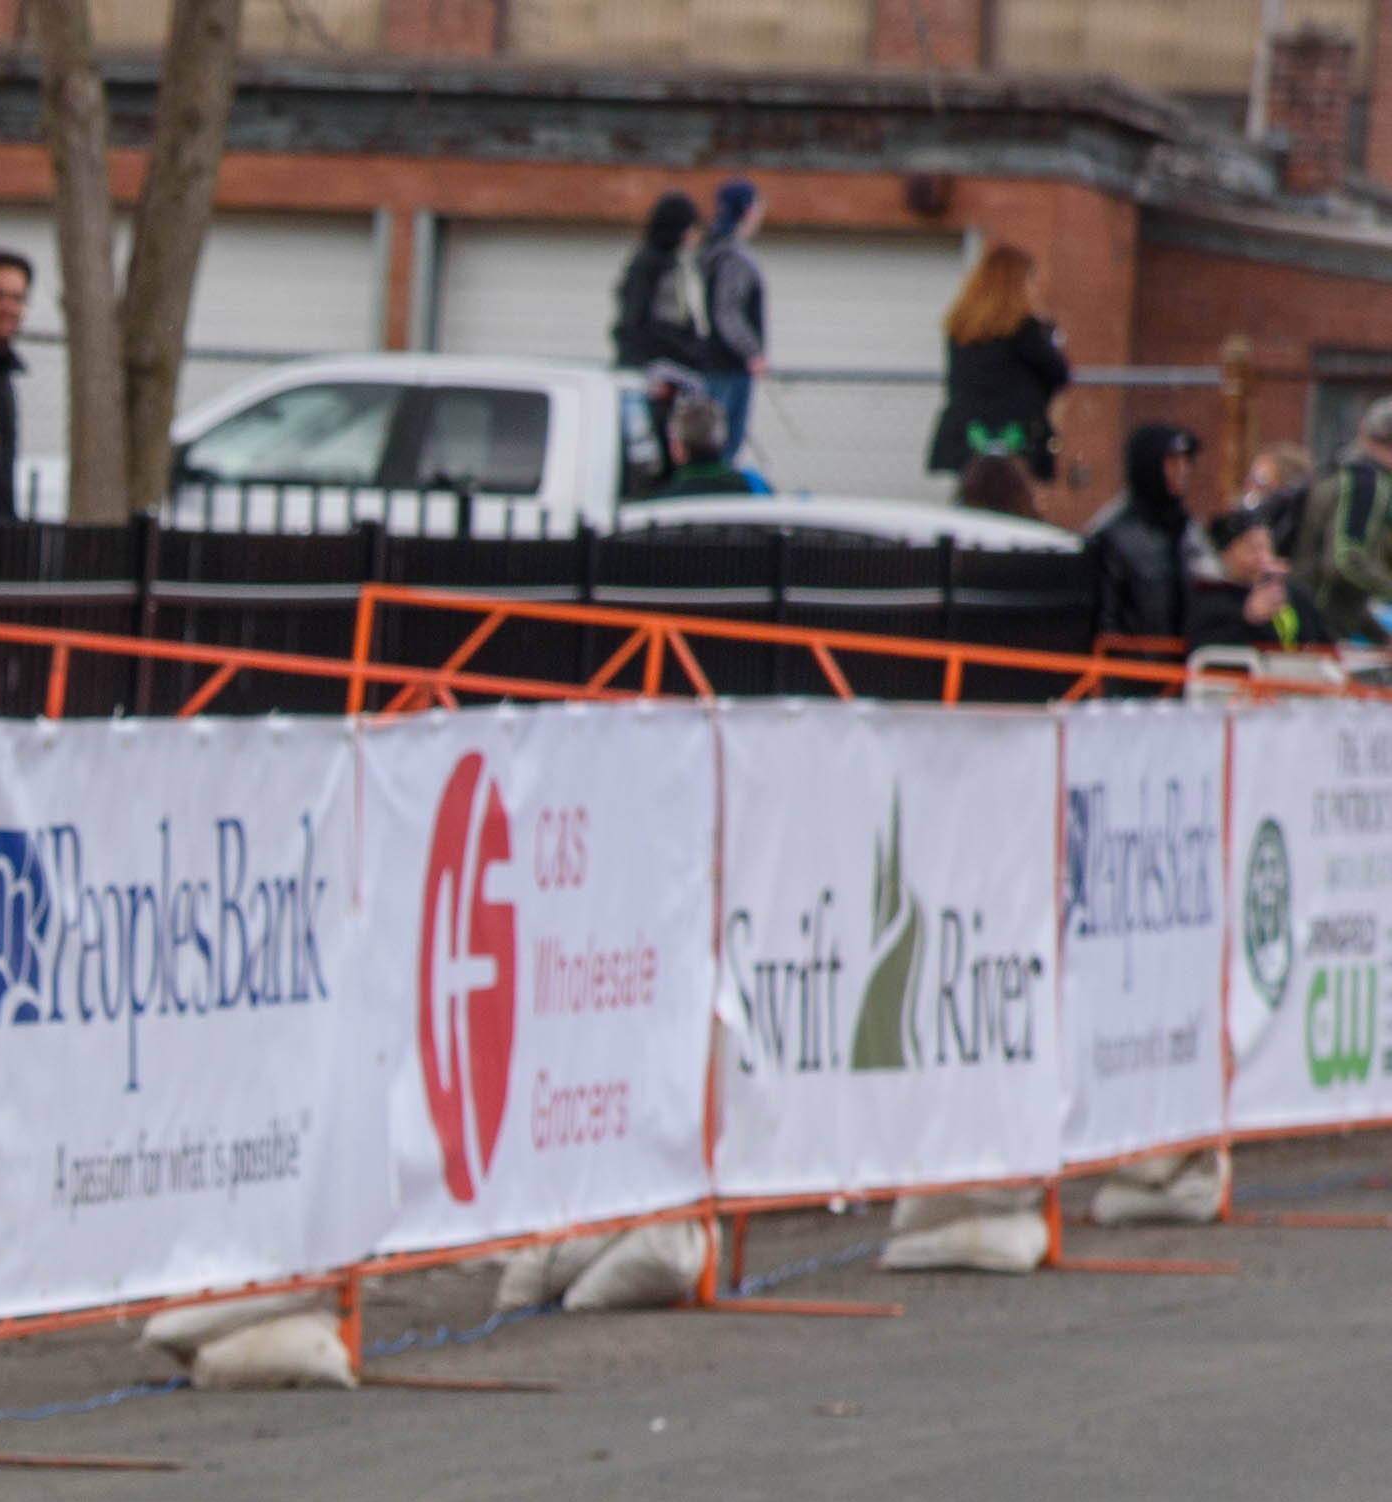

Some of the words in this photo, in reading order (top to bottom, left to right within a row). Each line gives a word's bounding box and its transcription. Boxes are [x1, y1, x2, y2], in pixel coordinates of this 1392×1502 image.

[534, 804, 589, 891] C&S
[48, 813, 330, 1093] PeoplesBank
[533, 930, 658, 1017] Wholesale
[725, 887, 843, 1074] Swift
[935, 909, 1043, 1066] River
[531, 1067, 629, 1151] Grocers
